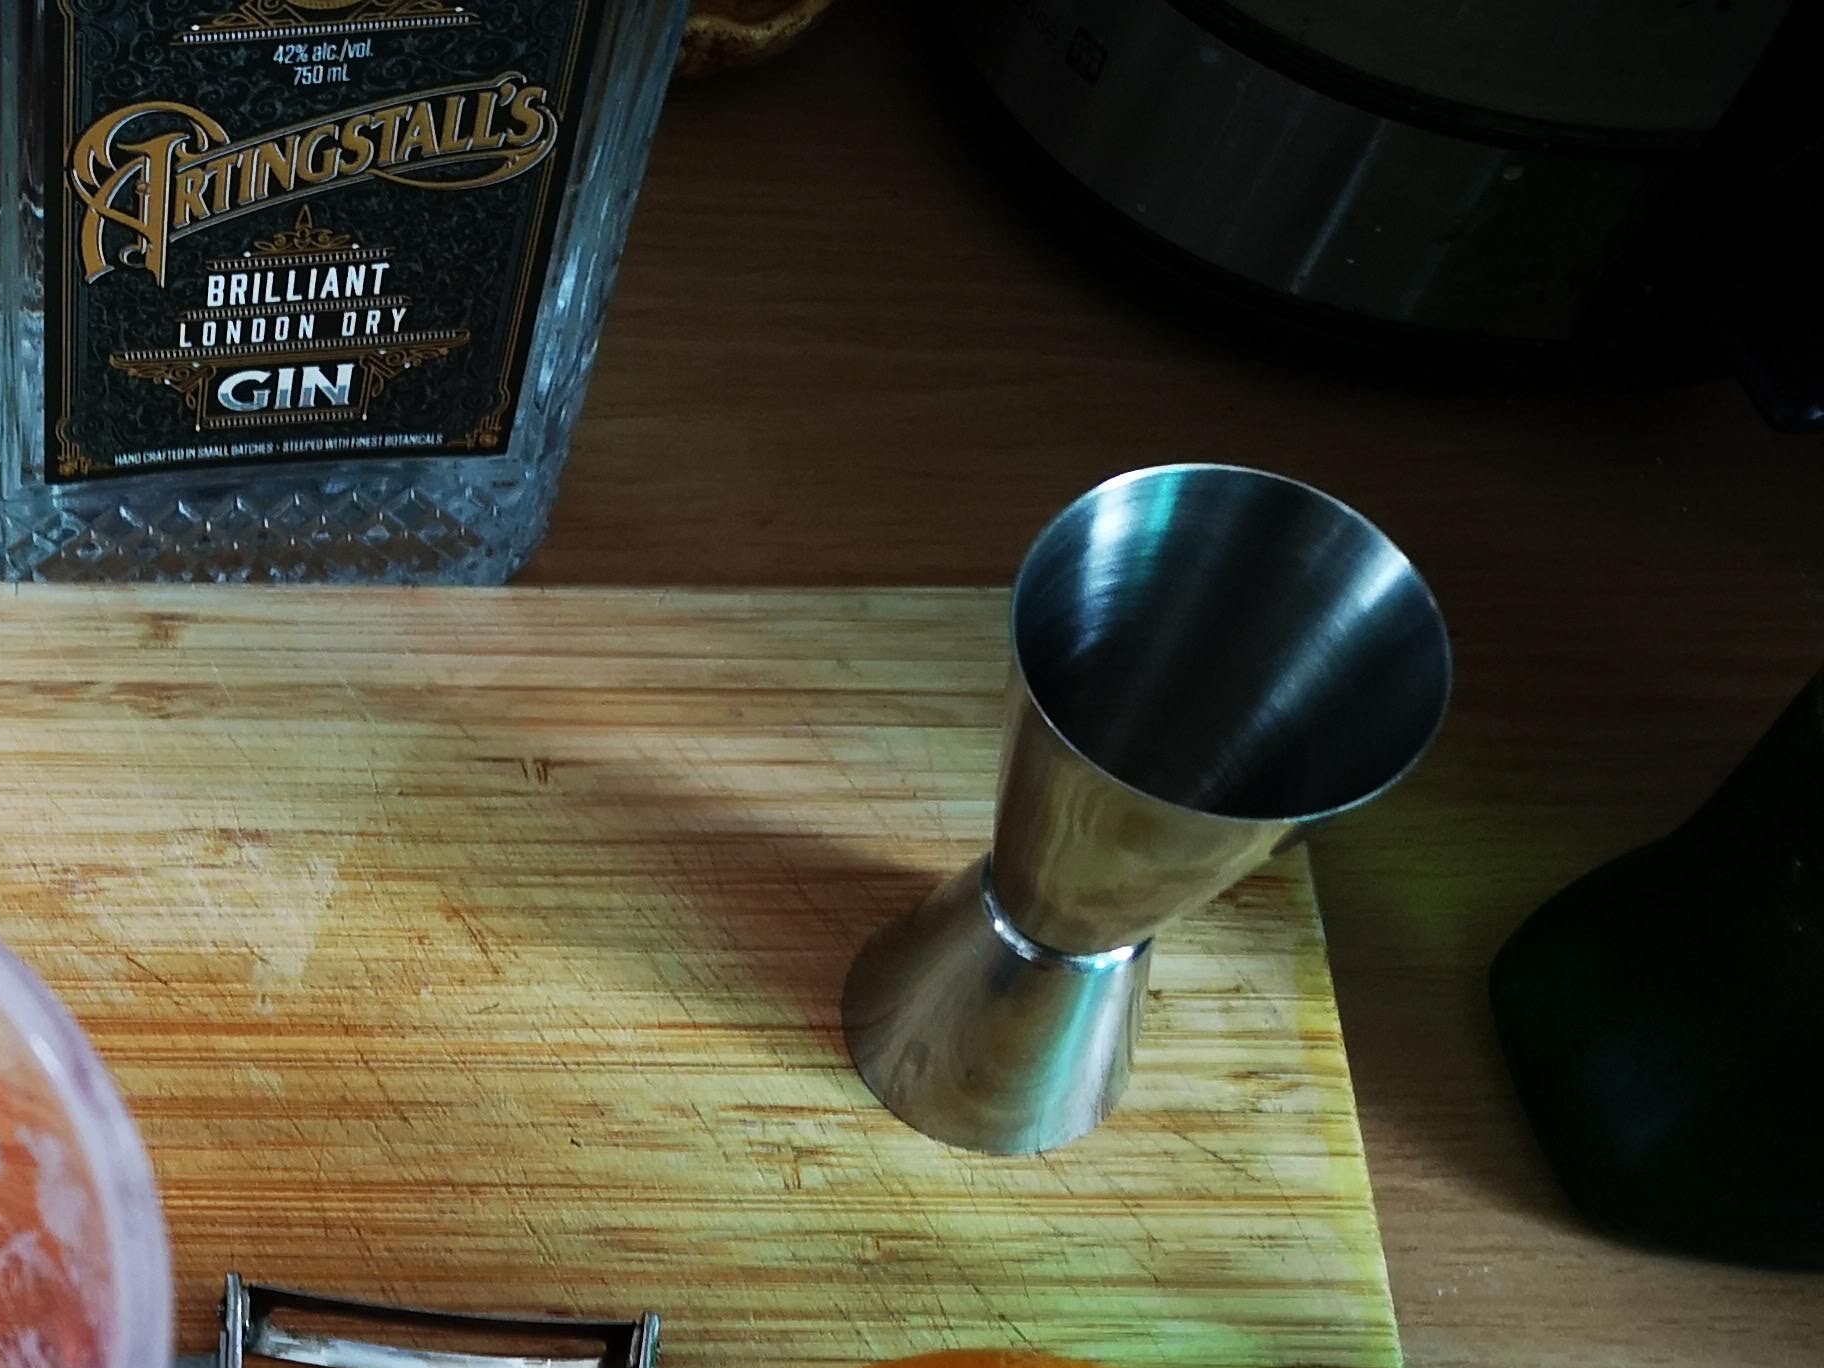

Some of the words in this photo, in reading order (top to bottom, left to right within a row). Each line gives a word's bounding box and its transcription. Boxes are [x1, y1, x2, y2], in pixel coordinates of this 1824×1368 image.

[273, 43, 309, 64] 42%
[293, 64, 324, 86] 750
[326, 62, 351, 83] mL
[70, 82, 547, 288] ARTINGSTALL'S
[207, 262, 390, 307] BRILLIANT
[179, 314, 315, 348] LONDON
[342, 307, 407, 337] DRY
[217, 363, 355, 412] GIN
[114, 452, 142, 466] HAND
[143, 448, 184, 464] CRAFTED
[185, 447, 196, 460] IN
[197, 444, 229, 459] SMALL
[231, 440, 274, 457] BATCHES
[325, 435, 350, 450] WITH
[350, 434, 384, 449] FINEST
[384, 432, 444, 448] BOTANICALS
